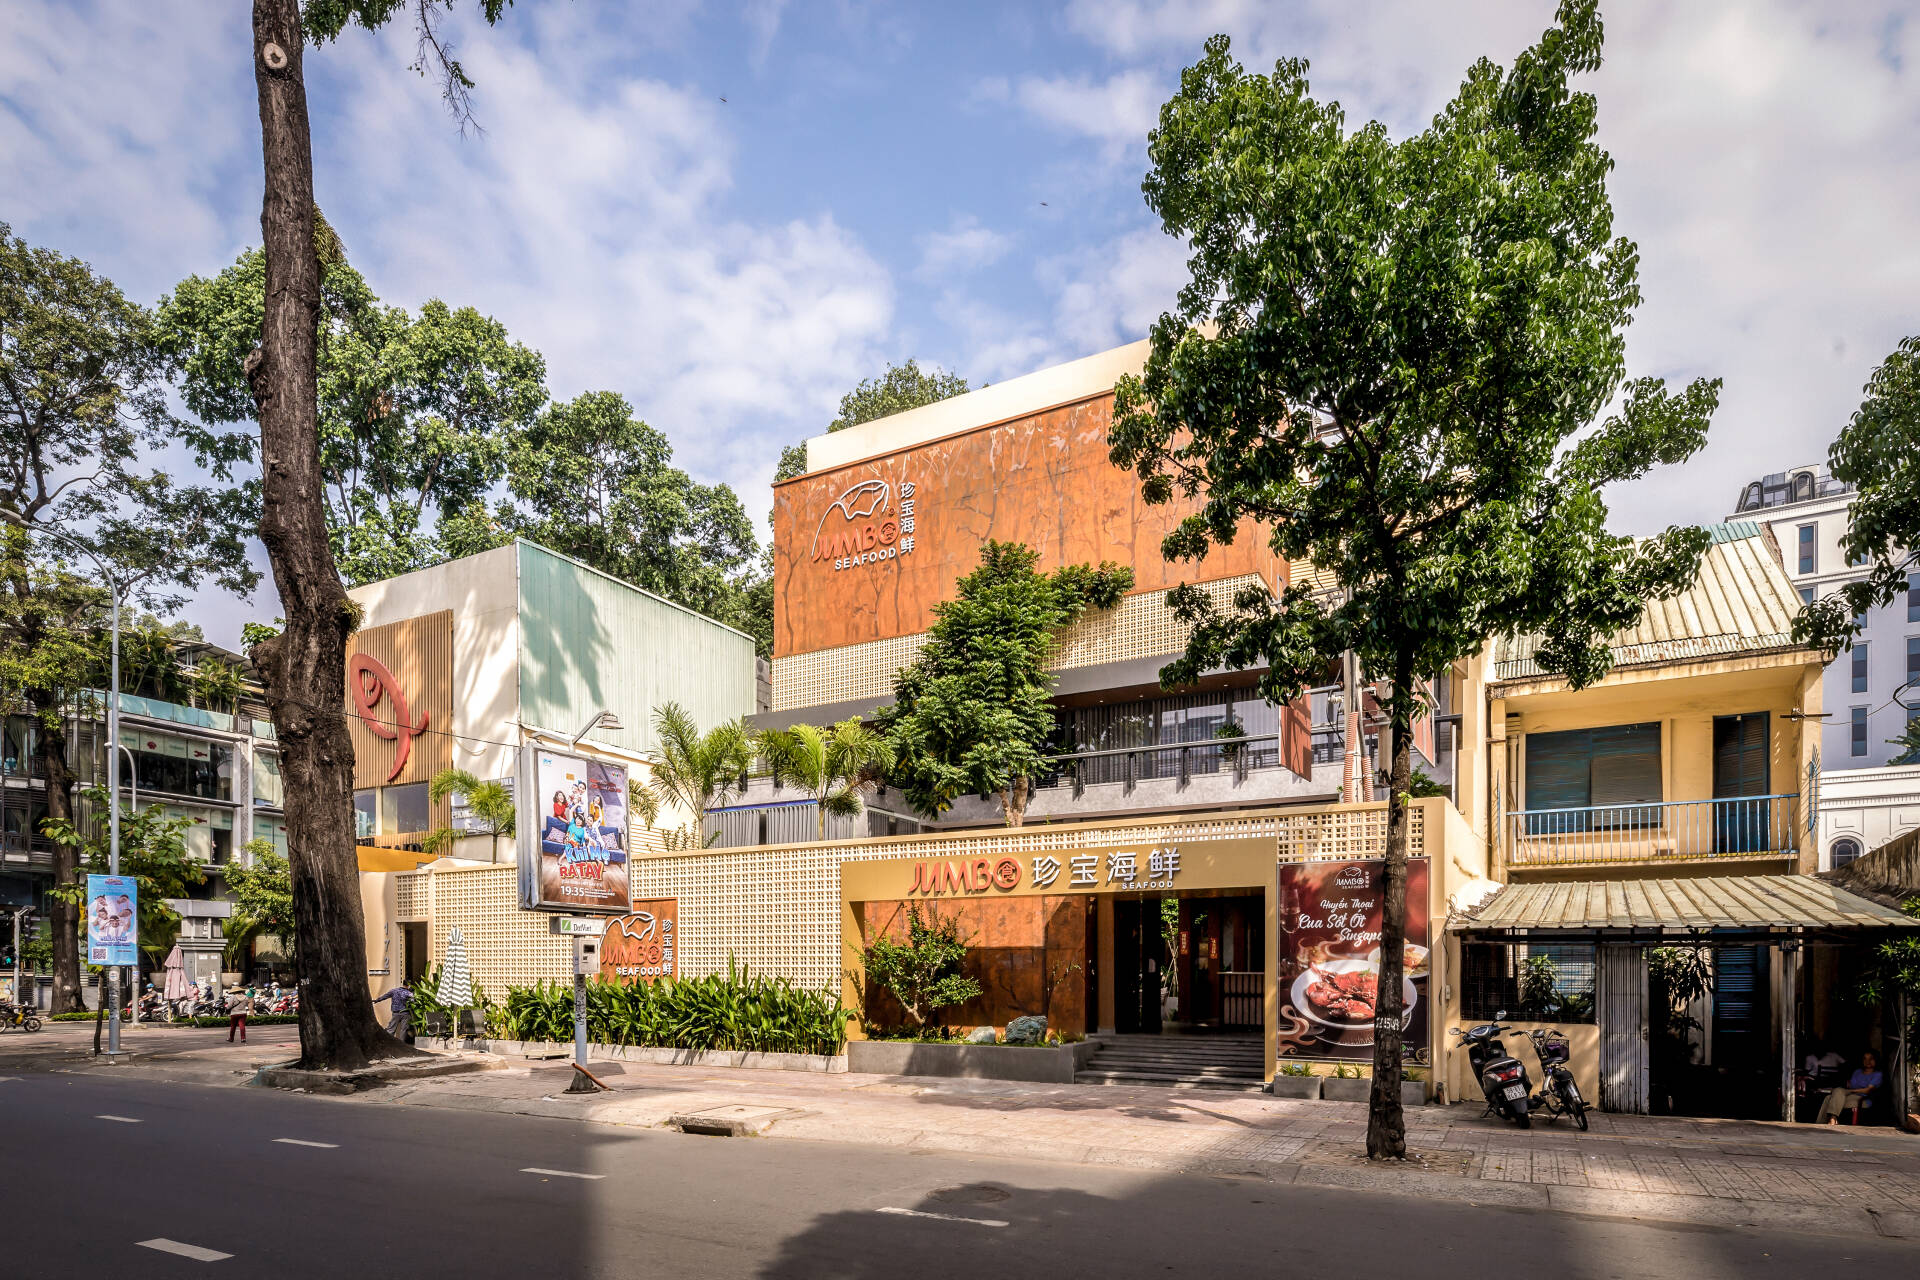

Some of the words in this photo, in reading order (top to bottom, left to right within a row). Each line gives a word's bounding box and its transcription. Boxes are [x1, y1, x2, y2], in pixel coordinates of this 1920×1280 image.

[900, 482, 915, 555] 珍宝海鲜
[814, 520, 899, 563] JUMBO
[835, 547, 896, 570] SEAFOOD
[908, 856, 1022, 893] JUMBO
[1032, 847, 1181, 886] 珍宝海鲜
[560, 885, 585, 897] 19:35
[1122, 881, 1174, 890] SEAFOOD
[1299, 914, 1323, 929] Cua
[601, 944, 661, 965] JUMBO
[662, 919, 673, 976] 珍宝海鲜
[616, 966, 661, 976] SEAFOOD
